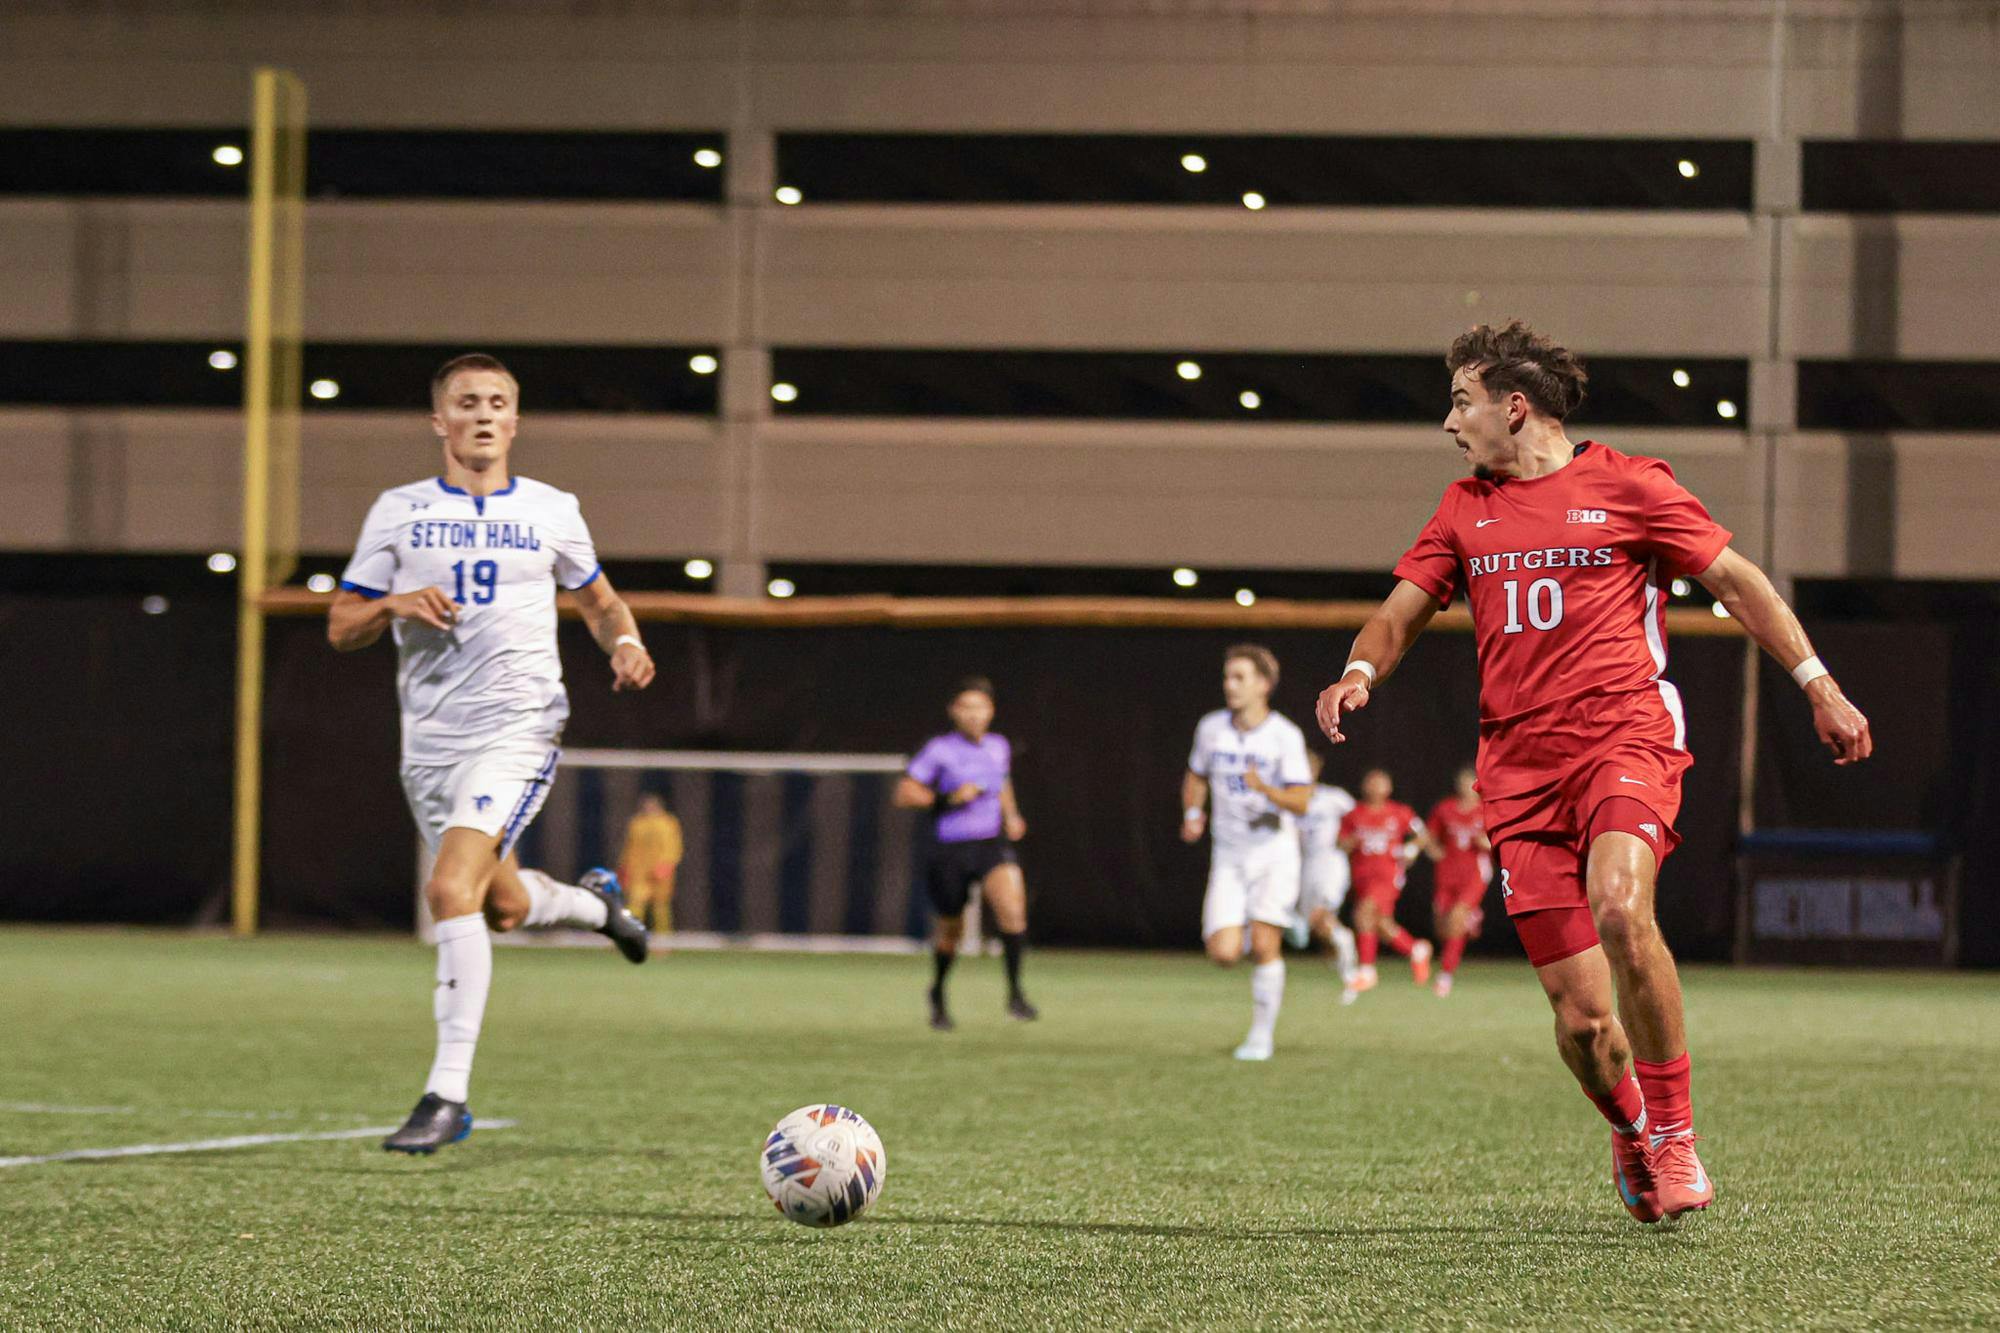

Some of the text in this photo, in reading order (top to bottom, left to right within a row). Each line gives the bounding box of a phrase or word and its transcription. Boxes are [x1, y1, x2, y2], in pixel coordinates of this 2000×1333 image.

[411, 522, 541, 552] SETON HALL
[1469, 547, 1613, 577] RUTGERS
[451, 559, 498, 605] 19
[1503, 577, 1564, 634] 10
